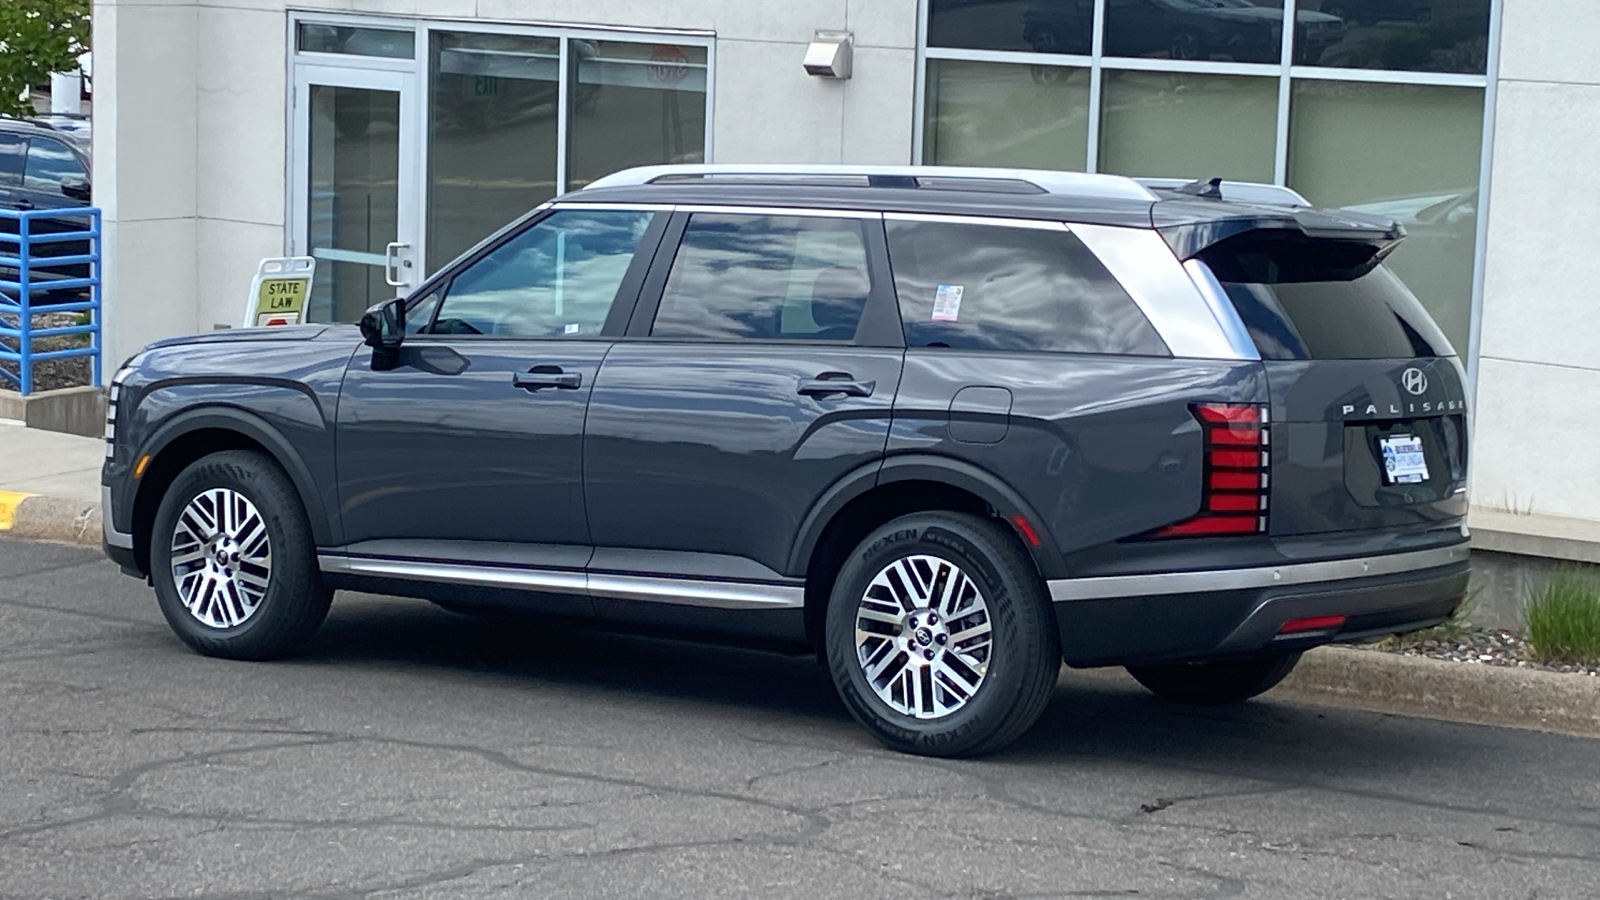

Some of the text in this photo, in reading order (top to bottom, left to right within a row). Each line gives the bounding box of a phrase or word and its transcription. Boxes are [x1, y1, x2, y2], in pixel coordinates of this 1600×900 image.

[475, 77, 498, 95] EXIT
[269, 283, 299, 295] STATE
[271, 298, 294, 308] LAW
[862, 528, 918, 562] NEXEN
